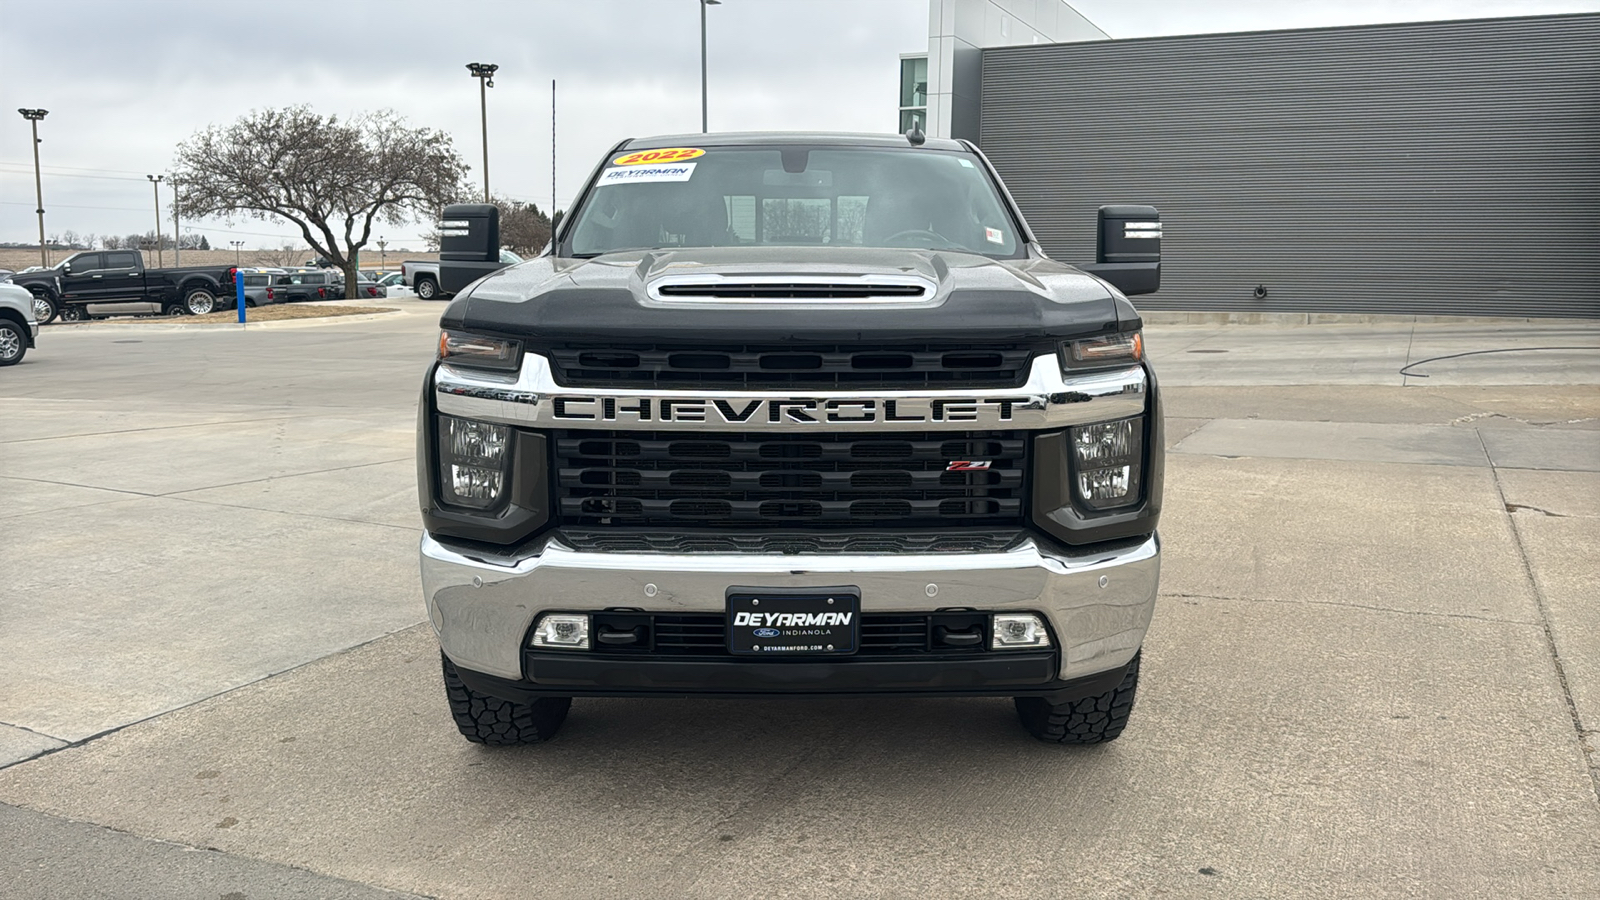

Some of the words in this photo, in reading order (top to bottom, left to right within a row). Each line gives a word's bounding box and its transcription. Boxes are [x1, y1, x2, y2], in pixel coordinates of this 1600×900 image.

[622, 149, 698, 164] 2022
[606, 168, 689, 178] DEYARMAN
[552, 397, 1031, 424] CHEVROLET
[733, 612, 852, 627] DEYARMAN
[757, 629, 776, 637] Ford
